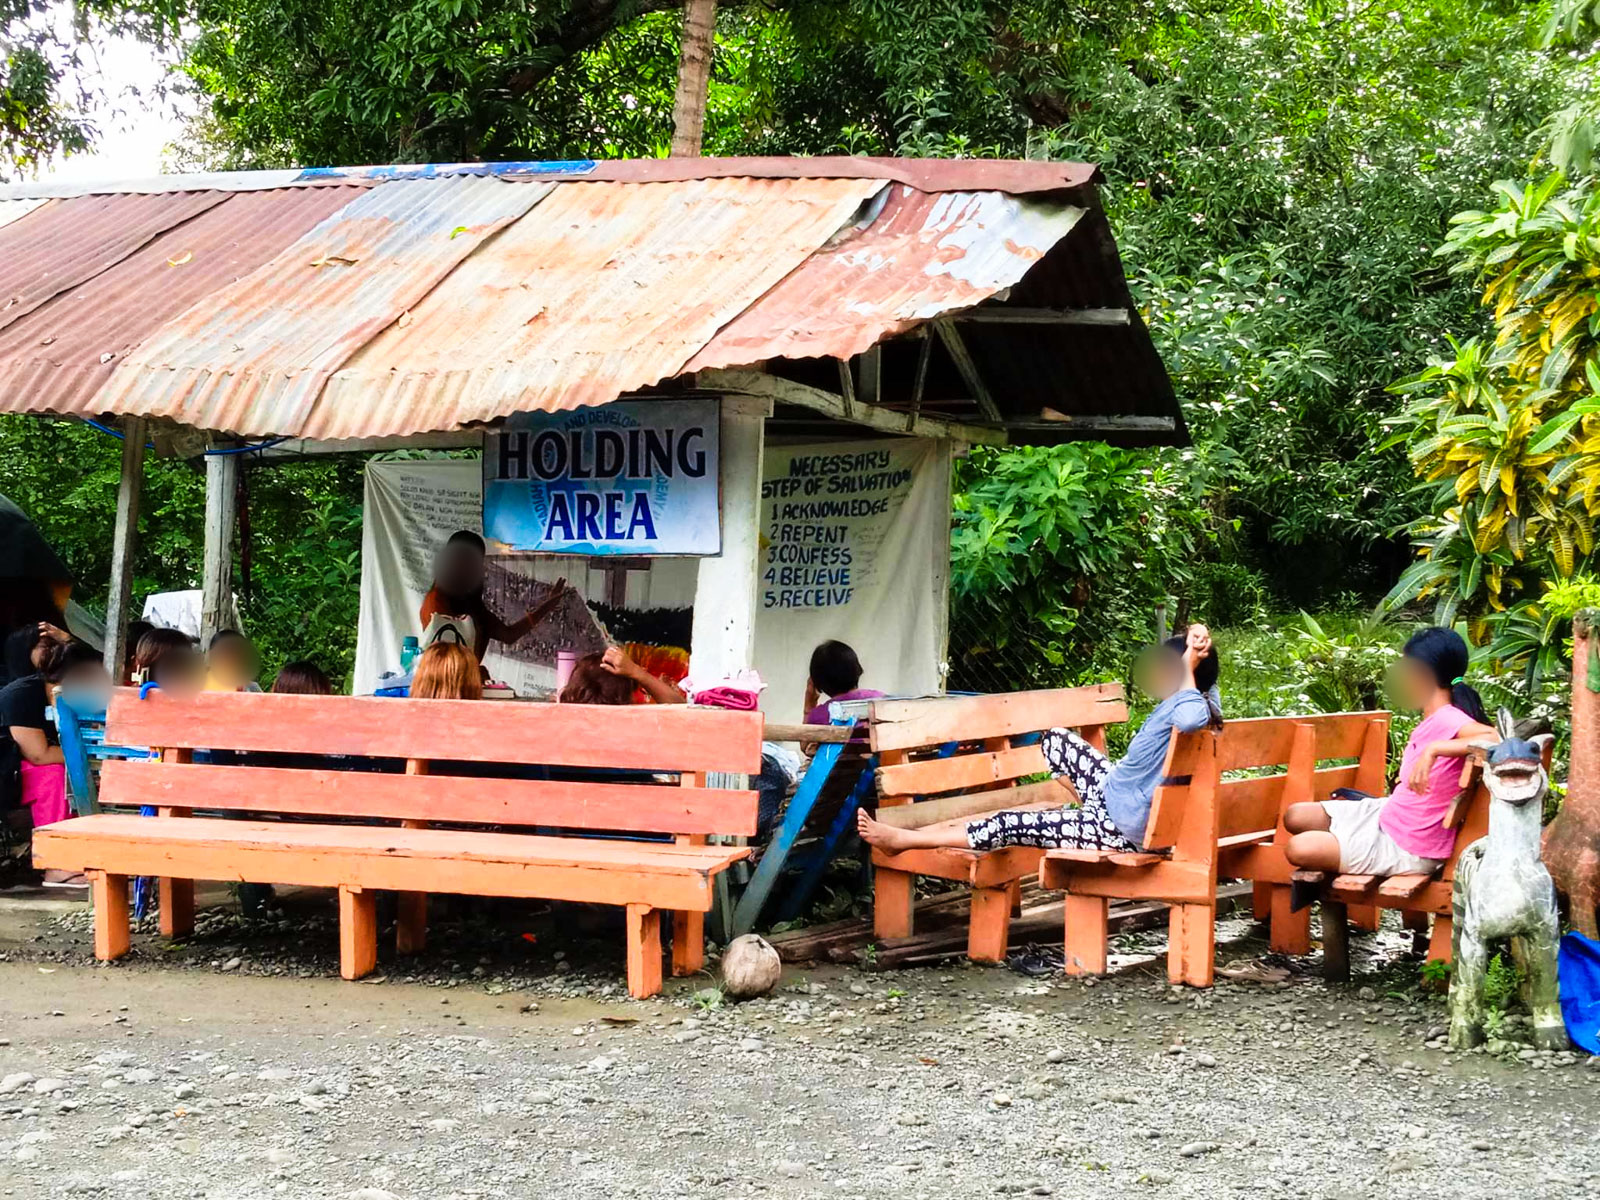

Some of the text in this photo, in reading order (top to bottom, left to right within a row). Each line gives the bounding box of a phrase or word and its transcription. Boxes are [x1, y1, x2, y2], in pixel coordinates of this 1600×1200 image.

[588, 410, 641, 428] DEVELOP
[497, 427, 706, 479] HOLDING
[789, 450, 891, 477] NECESSARY
[761, 468, 912, 499] STEP OF SALVATION
[545, 492, 658, 540] AREA
[782, 497, 889, 520] ACKNOWLEDGE
